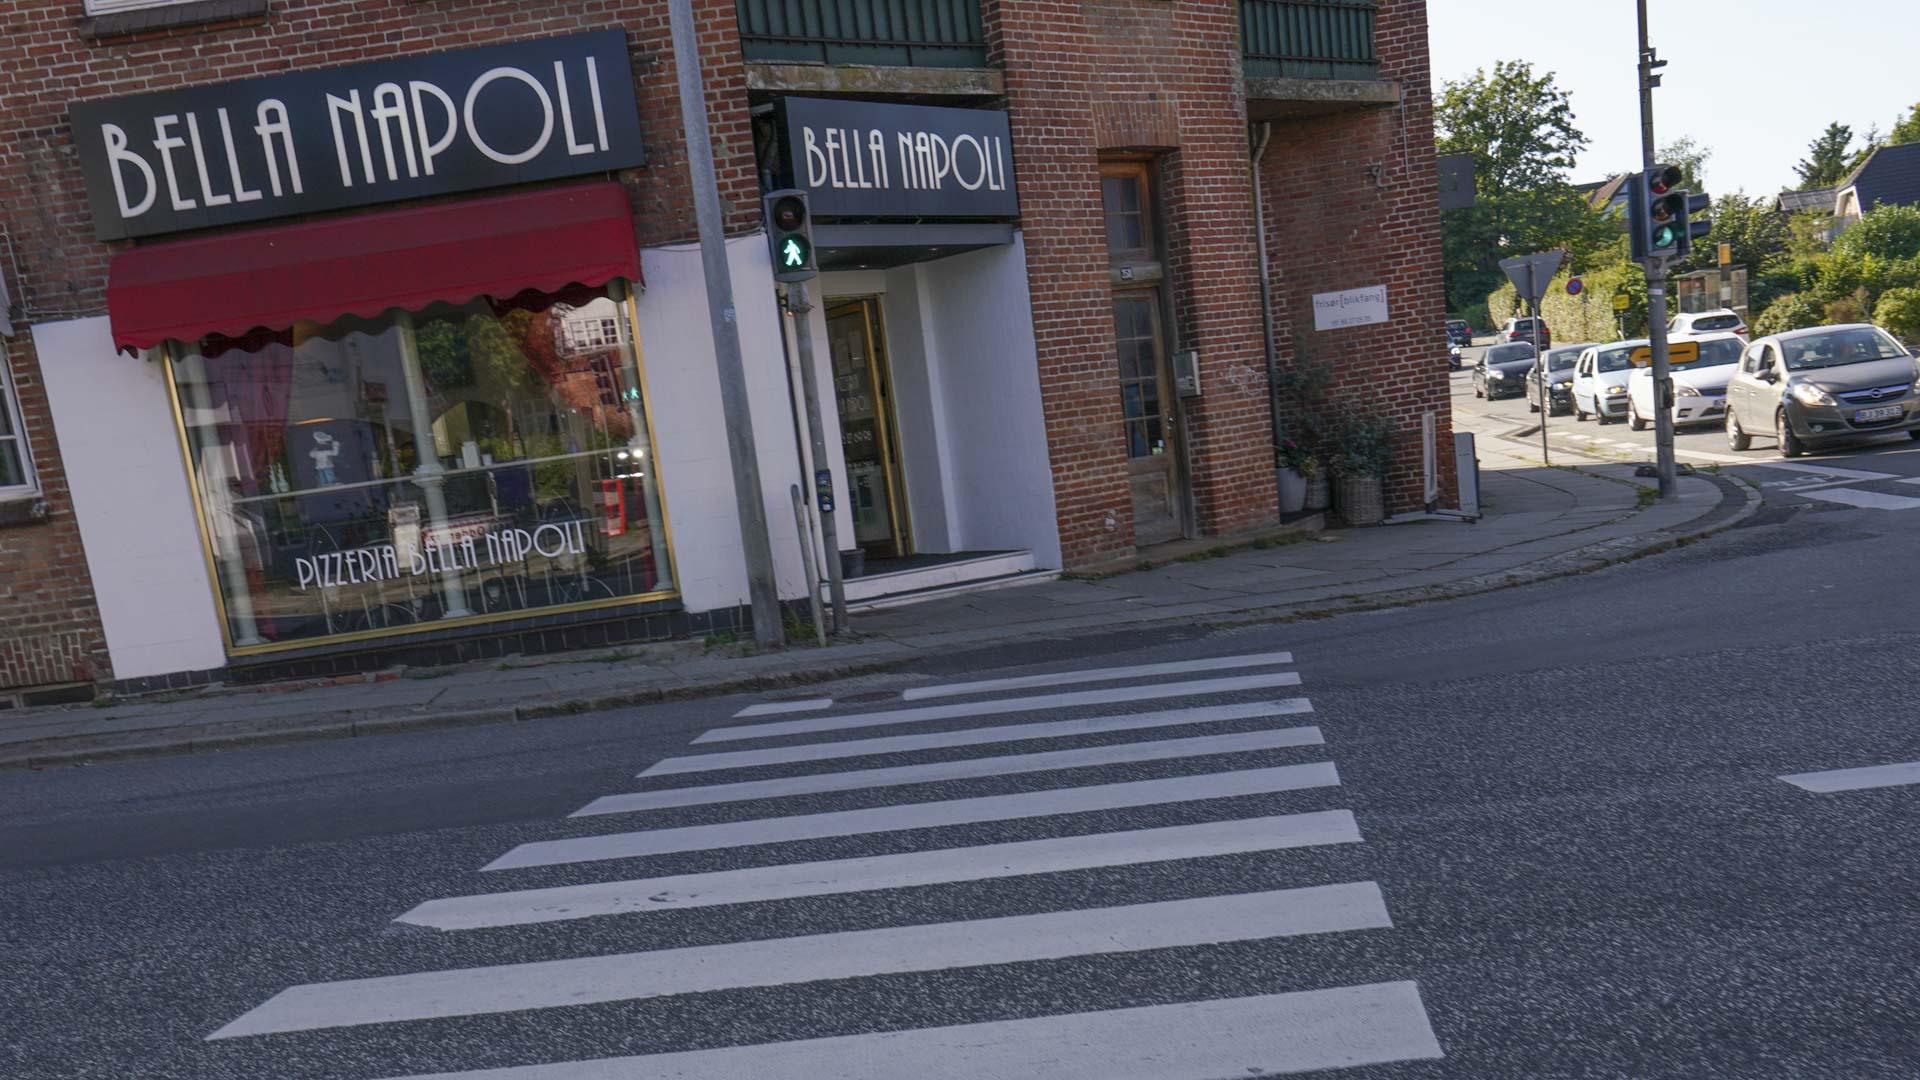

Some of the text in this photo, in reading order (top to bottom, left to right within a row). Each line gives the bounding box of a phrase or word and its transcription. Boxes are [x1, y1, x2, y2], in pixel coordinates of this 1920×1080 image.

[101, 56, 609, 218] BELLA NAPOLI
[803, 126, 1006, 191] BELLA NAPOLI
[295, 520, 585, 591] PIZZERIA BELLA NAPOLI
